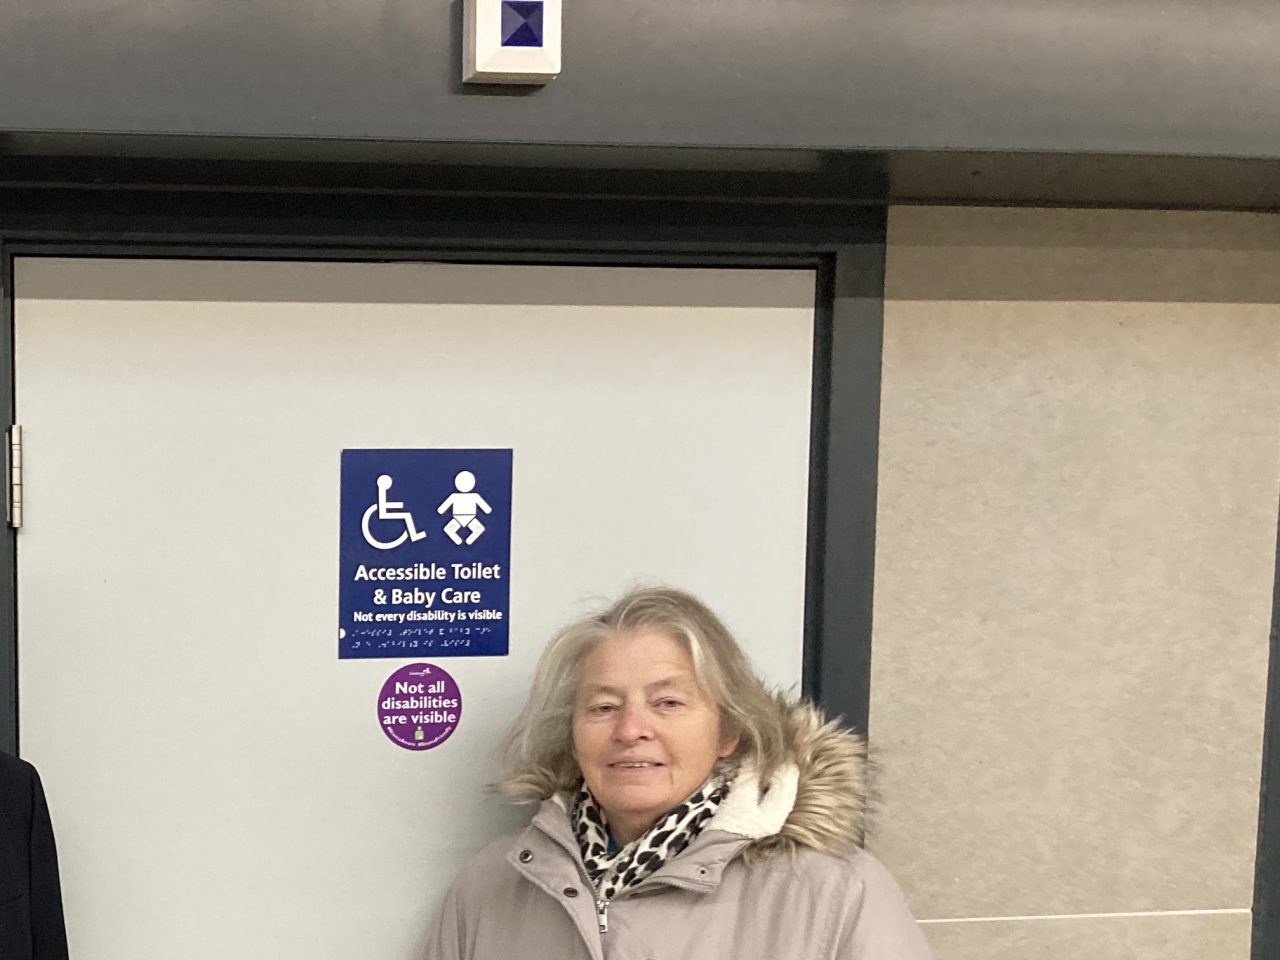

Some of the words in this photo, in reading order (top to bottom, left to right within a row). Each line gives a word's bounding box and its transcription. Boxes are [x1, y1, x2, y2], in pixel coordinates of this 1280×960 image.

[354, 563, 447, 581] Accessible
[451, 562, 501, 579] Toilet
[373, 588, 387, 605] &
[391, 587, 436, 608] Baby
[441, 587, 481, 604] Care
[353, 611, 373, 622] Not
[375, 613, 405, 624] every
[406, 610, 456, 623] disability
[457, 610, 466, 620] is
[468, 609, 503, 620] visible
[395, 681, 424, 694] Not
[428, 680, 445, 694] all
[381, 696, 458, 710] disabilities
[382, 714, 407, 724] are
[411, 710, 456, 724] visible
